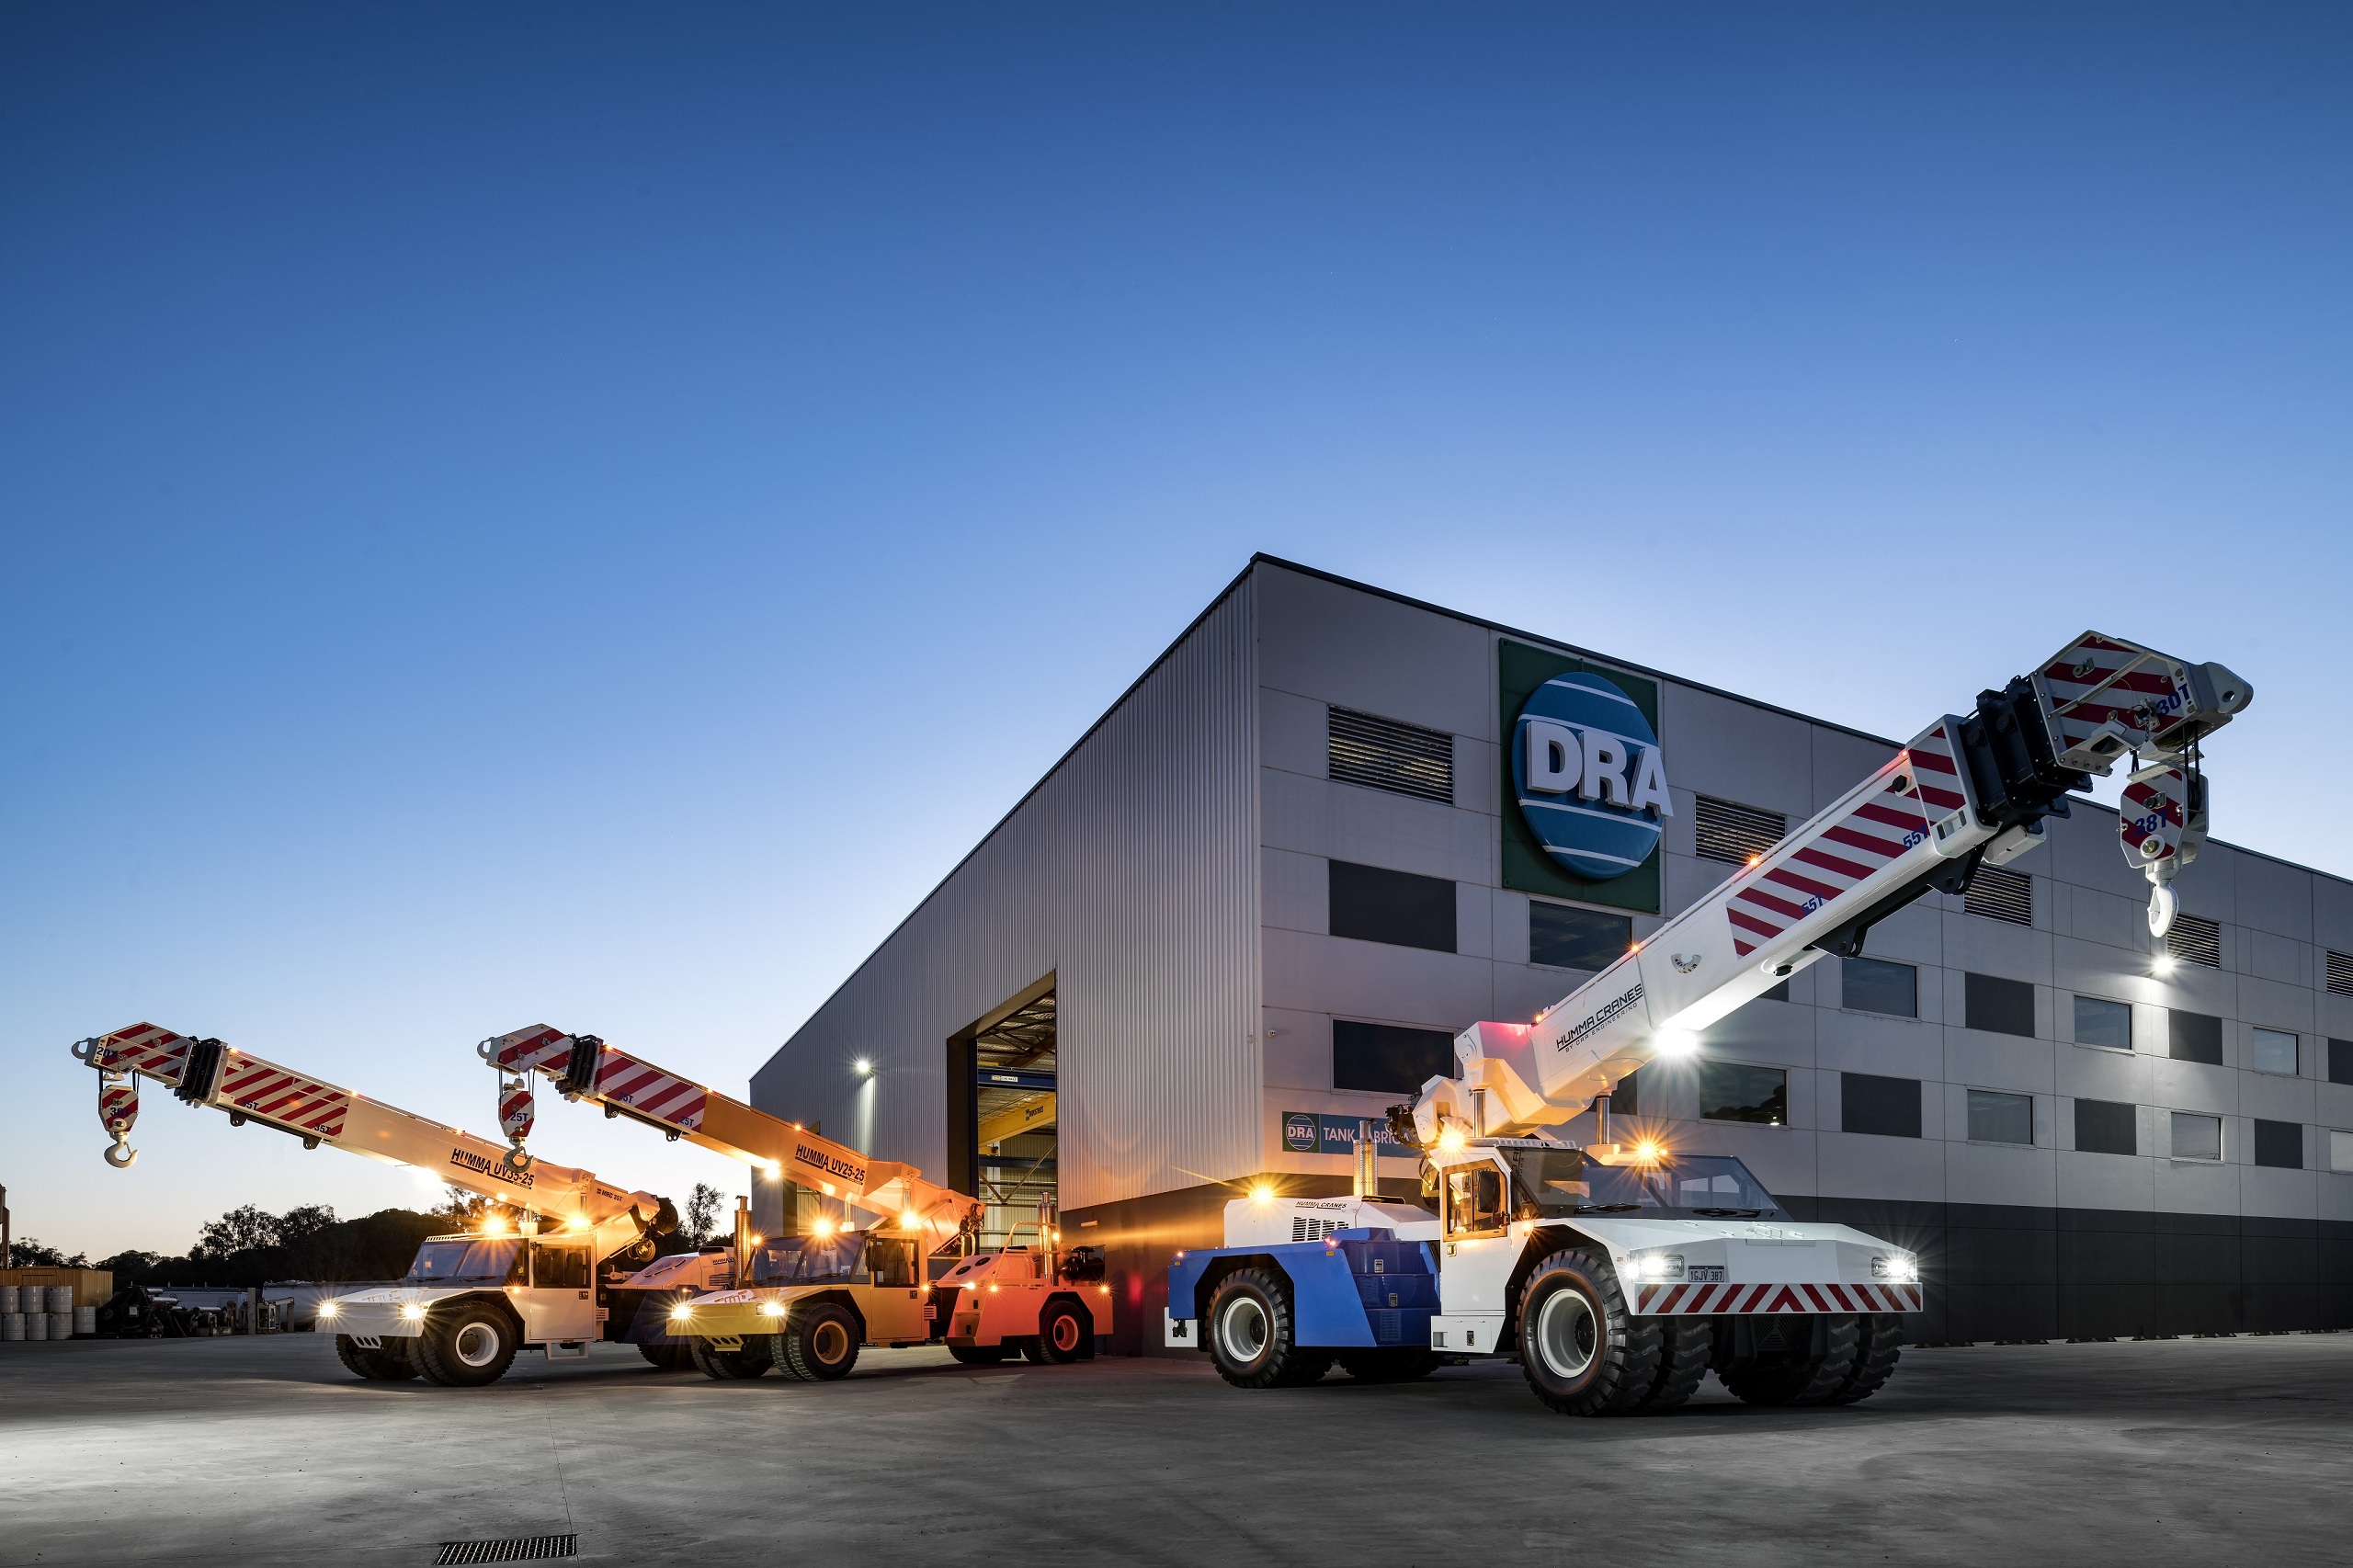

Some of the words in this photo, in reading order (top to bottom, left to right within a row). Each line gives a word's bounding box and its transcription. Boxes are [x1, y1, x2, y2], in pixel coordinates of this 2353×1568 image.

[2155, 683, 2189, 718] 30T
[1527, 720, 1674, 817] DRA
[2134, 809, 2169, 836] 38T
[1903, 822, 1928, 850] 55T
[1801, 892, 1824, 915] 55T
[1556, 1016, 1595, 1049] HUMMA
[1596, 983, 1643, 1022] CRANES
[1564, 1043, 1574, 1053] BY
[1591, 1002, 1638, 1036] ENGINEERING
[97, 1046, 119, 1060] 20T
[242, 1098, 259, 1110] 35T
[619, 1091, 634, 1104] 25T
[109, 1107, 131, 1118] 30T
[509, 1112, 529, 1122] 25T
[313, 1122, 331, 1134] 35T
[679, 1115, 695, 1128] 25T
[1288, 1126, 1314, 1139] DRA
[1324, 1127, 1356, 1142] TANK
[450, 1147, 492, 1179] HUMMA
[796, 1143, 829, 1172] HUMMA
[831, 1159, 865, 1182] UV25-25
[1295, 1200, 1320, 1209] HUMMA
